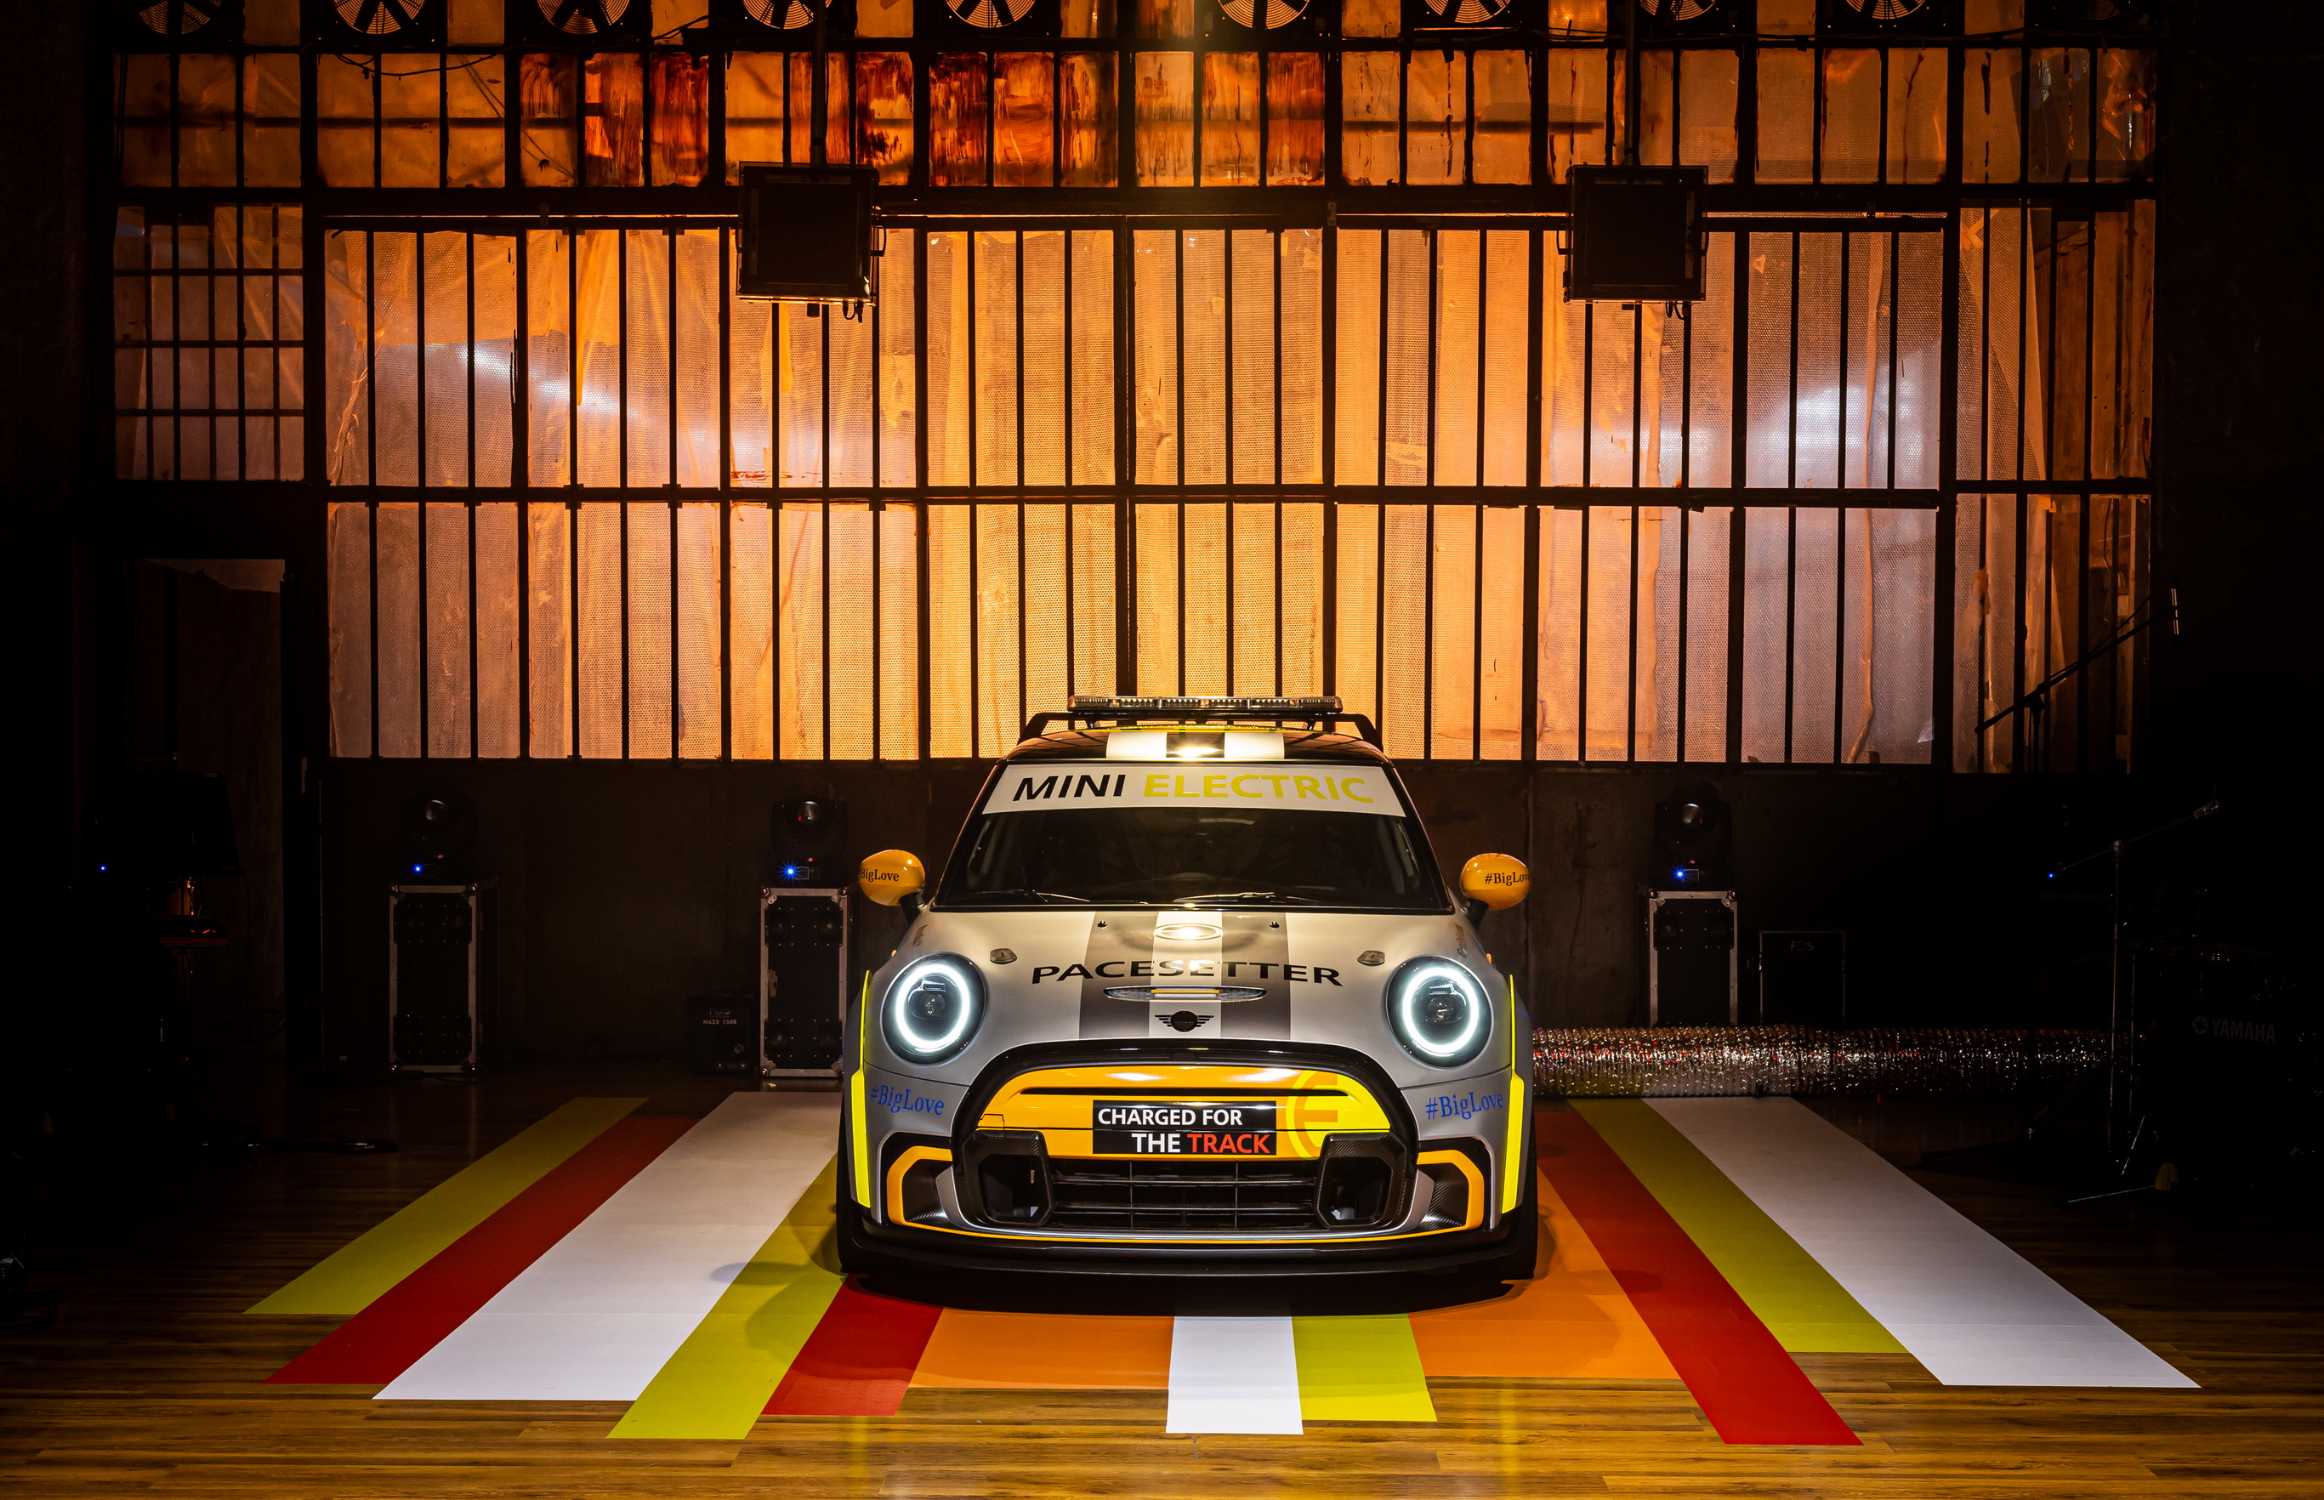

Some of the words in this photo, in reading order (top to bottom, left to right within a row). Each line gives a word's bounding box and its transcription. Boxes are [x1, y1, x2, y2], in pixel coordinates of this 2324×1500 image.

[1012, 774, 1126, 801] MINI
[1143, 773, 1374, 803] ELECTRIC
[1031, 960, 1344, 987] PACESETTER
[2211, 1018, 2277, 1044] YAMAHA
[1098, 1108, 1196, 1126] CHARGED
[1202, 1109, 1243, 1126] FOR
[1425, 1091, 1504, 1120] #BigLove
[1131, 1133, 1181, 1153] THE
[1186, 1133, 1270, 1154] TRACK
